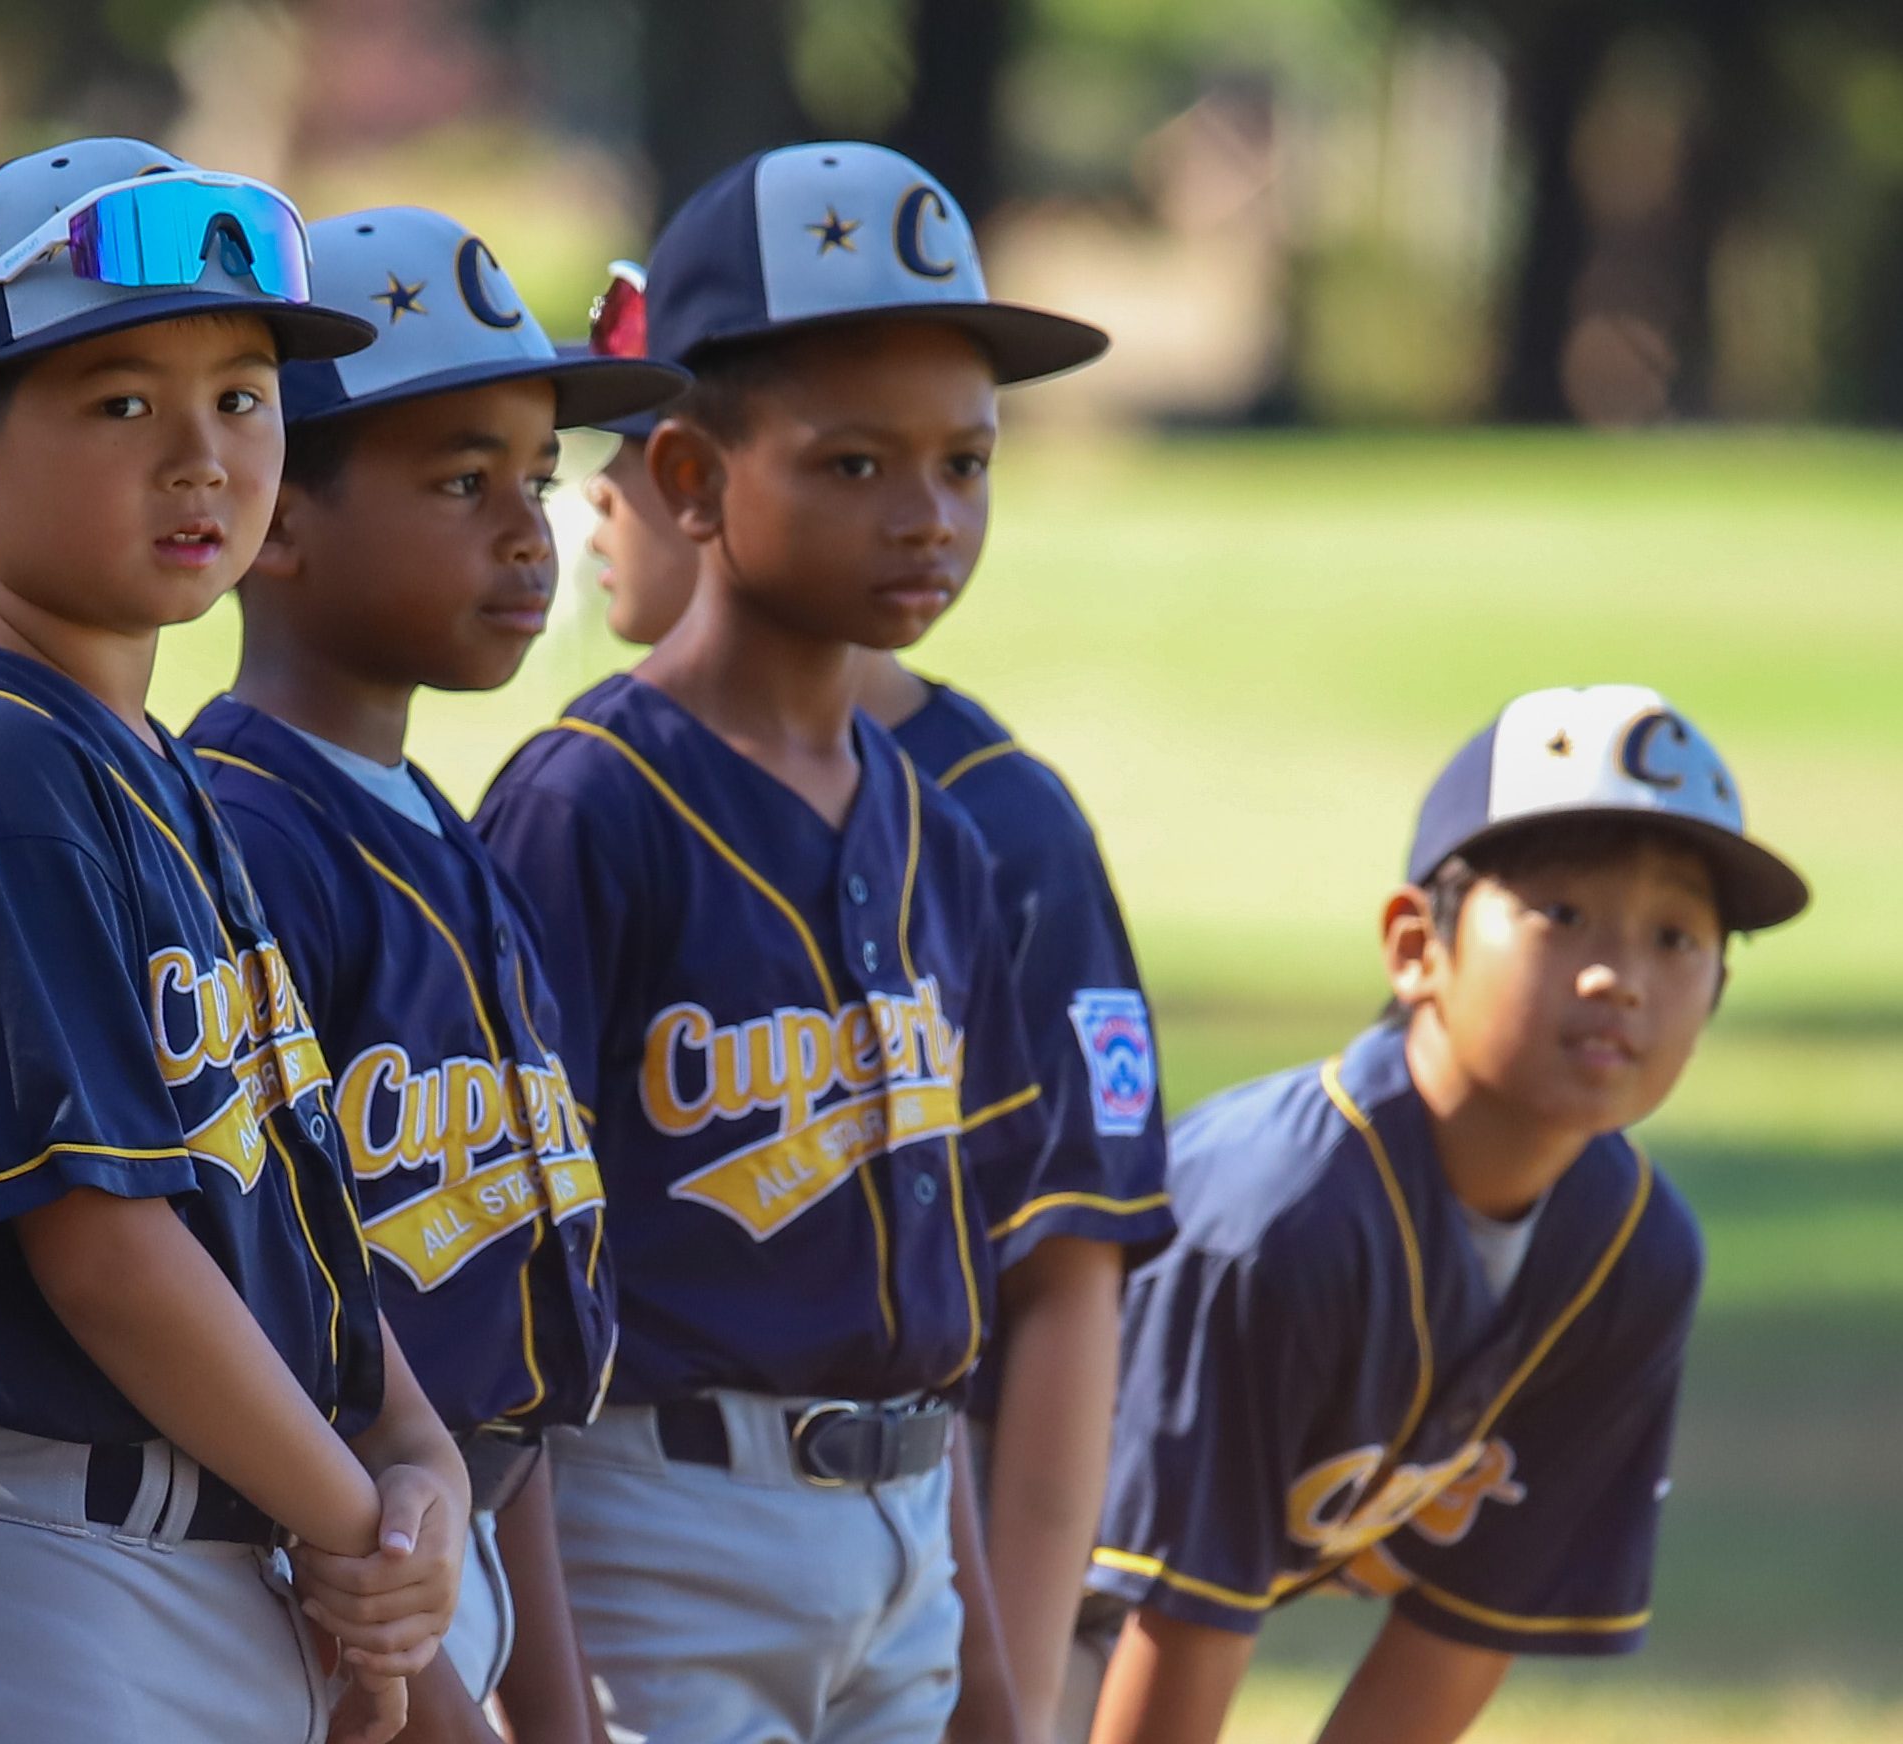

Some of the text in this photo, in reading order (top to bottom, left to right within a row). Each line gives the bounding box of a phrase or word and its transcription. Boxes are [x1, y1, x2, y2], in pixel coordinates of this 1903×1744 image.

[893, 183, 955, 283] C
[455, 236, 524, 331] C
[1611, 706, 1685, 790] C
[754, 1154, 818, 1210] ALL
[421, 1208, 473, 1260] ALL
